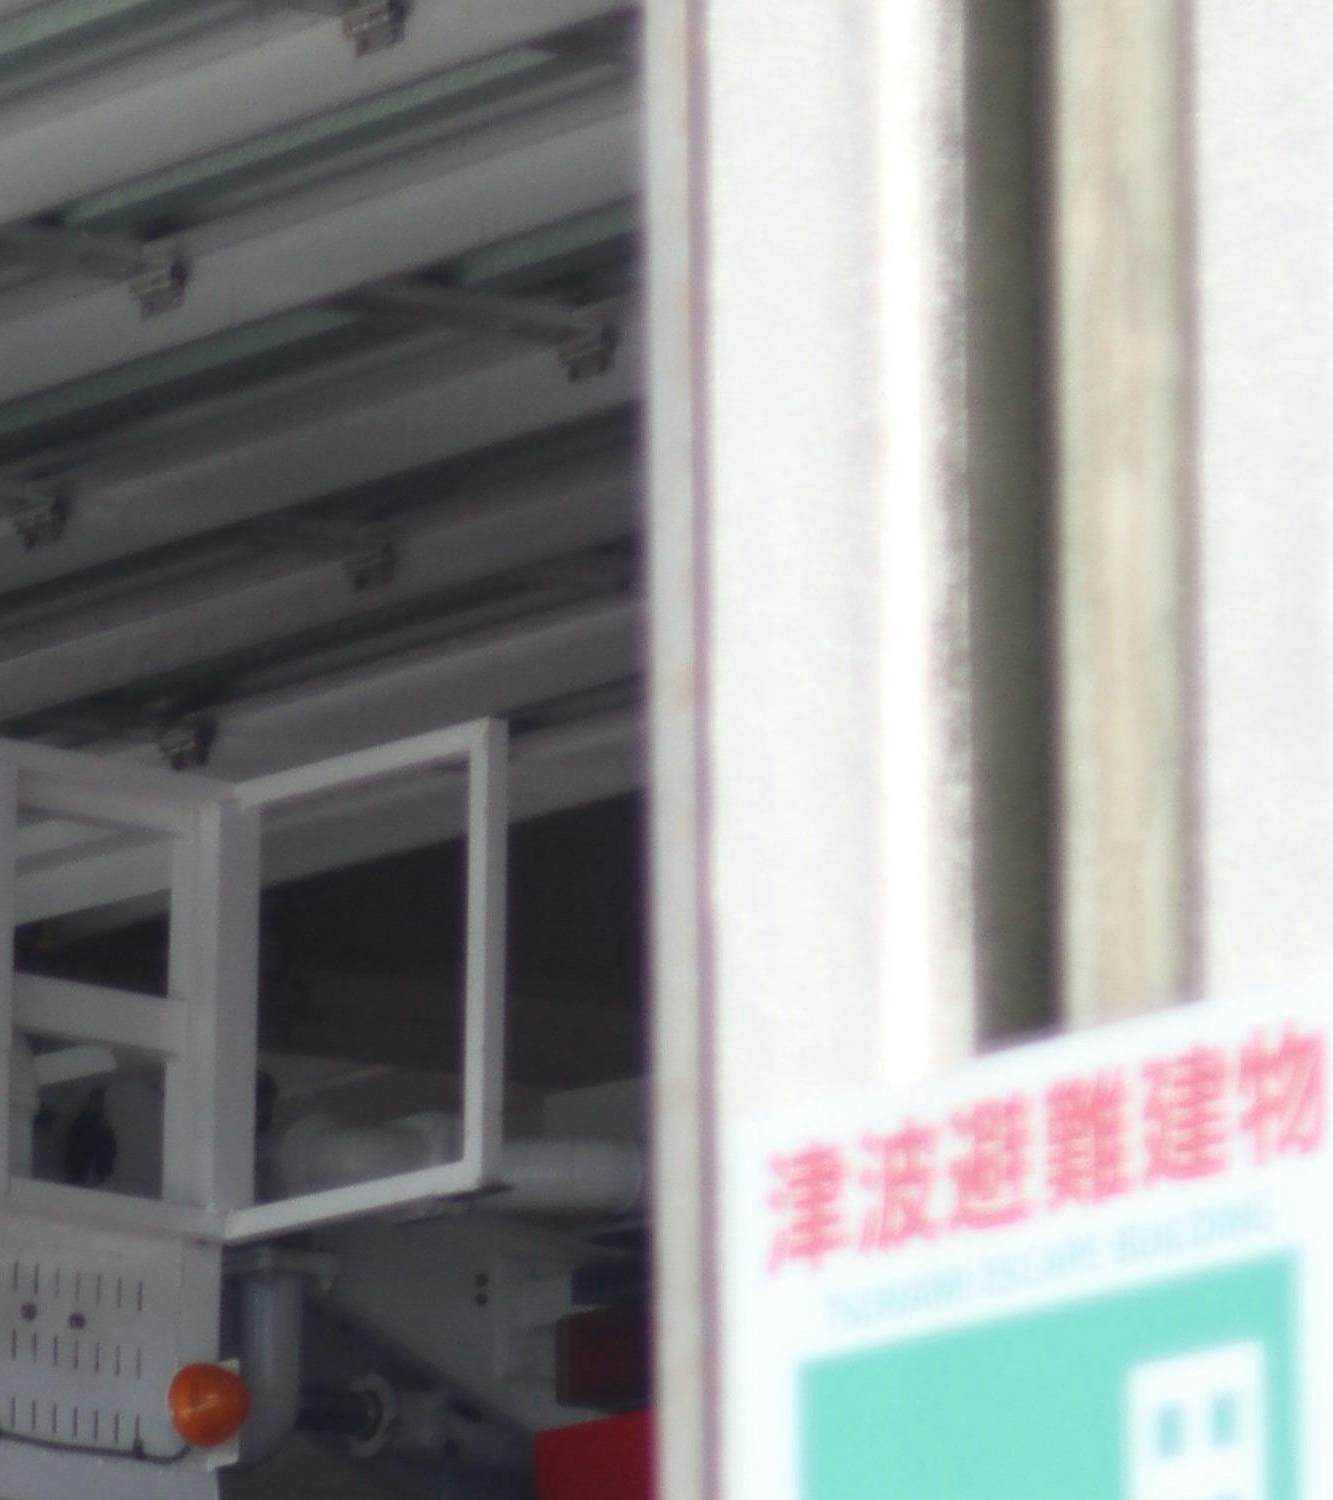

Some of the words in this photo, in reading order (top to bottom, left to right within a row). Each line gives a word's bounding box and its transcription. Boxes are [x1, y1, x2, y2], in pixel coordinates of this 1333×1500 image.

[766, 1023, 1326, 1274] 津波避難建物
